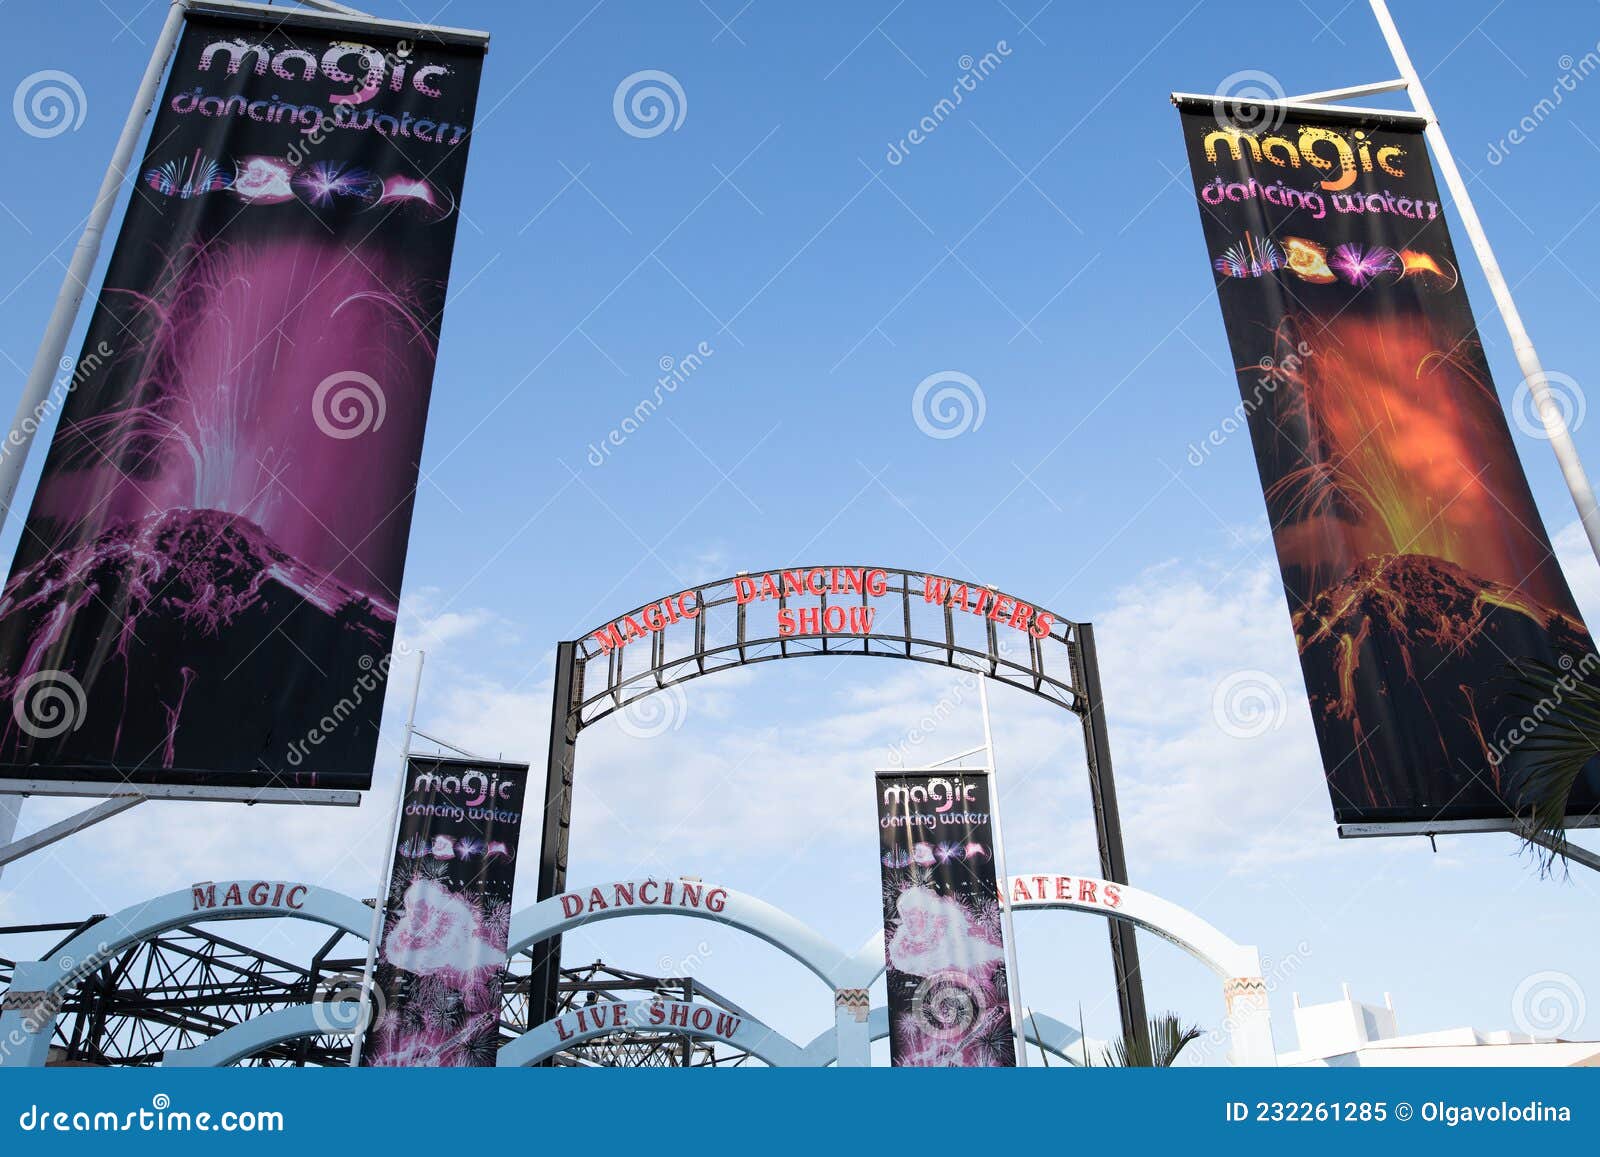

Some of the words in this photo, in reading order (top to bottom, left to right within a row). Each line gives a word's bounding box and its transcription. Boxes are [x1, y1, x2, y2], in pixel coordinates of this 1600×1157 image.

[199, 38, 455, 105] magic
[170, 88, 322, 133] dancing
[334, 108, 466, 145] waters
[1203, 126, 1406, 191] magic
[1202, 177, 1326, 219] dancing
[1332, 190, 1438, 220] waters
[594, 590, 700, 656] MAGIC
[734, 567, 888, 605] DANCING
[924, 575, 1056, 640] WATERS
[777, 605, 876, 636] SHOW
[413, 768, 514, 806] magic
[883, 777, 978, 813] magic
[405, 801, 464, 823] dancing
[468, 807, 520, 825] waters
[880, 811, 937, 830] dancing
[939, 810, 990, 825] waters
[192, 881, 308, 910] MAGIC
[560, 879, 728, 919] DANCING
[997, 876, 1122, 908] ATERS
[555, 1003, 628, 1041] LIVE
[649, 1002, 741, 1039] SHOW
